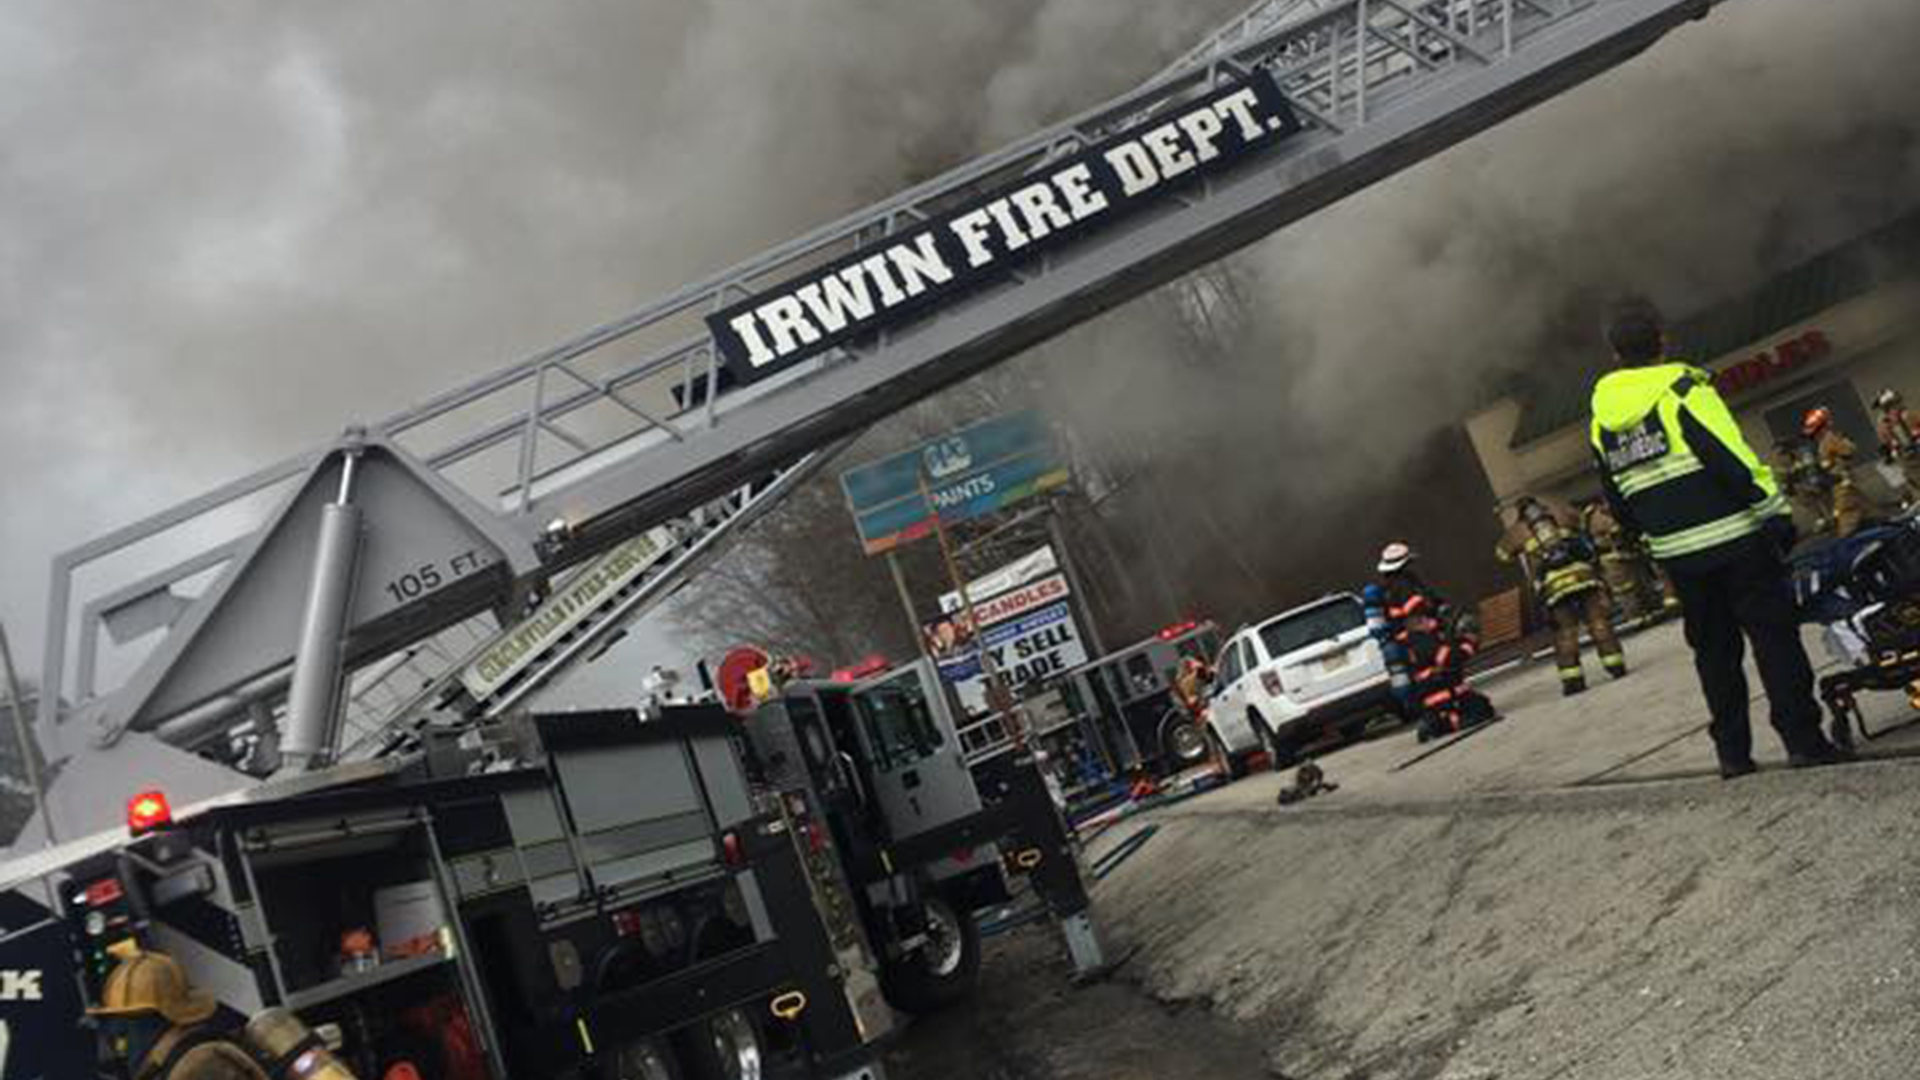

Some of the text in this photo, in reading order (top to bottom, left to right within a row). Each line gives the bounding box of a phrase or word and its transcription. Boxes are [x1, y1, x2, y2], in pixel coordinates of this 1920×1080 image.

[731, 86, 1281, 368] IRWIN FIRE DEPT.
[938, 472, 995, 507] AINTS
[385, 551, 487, 602] 105 FT.
[974, 579, 1063, 623] CANDLES
[1014, 623, 1073, 659] SELL
